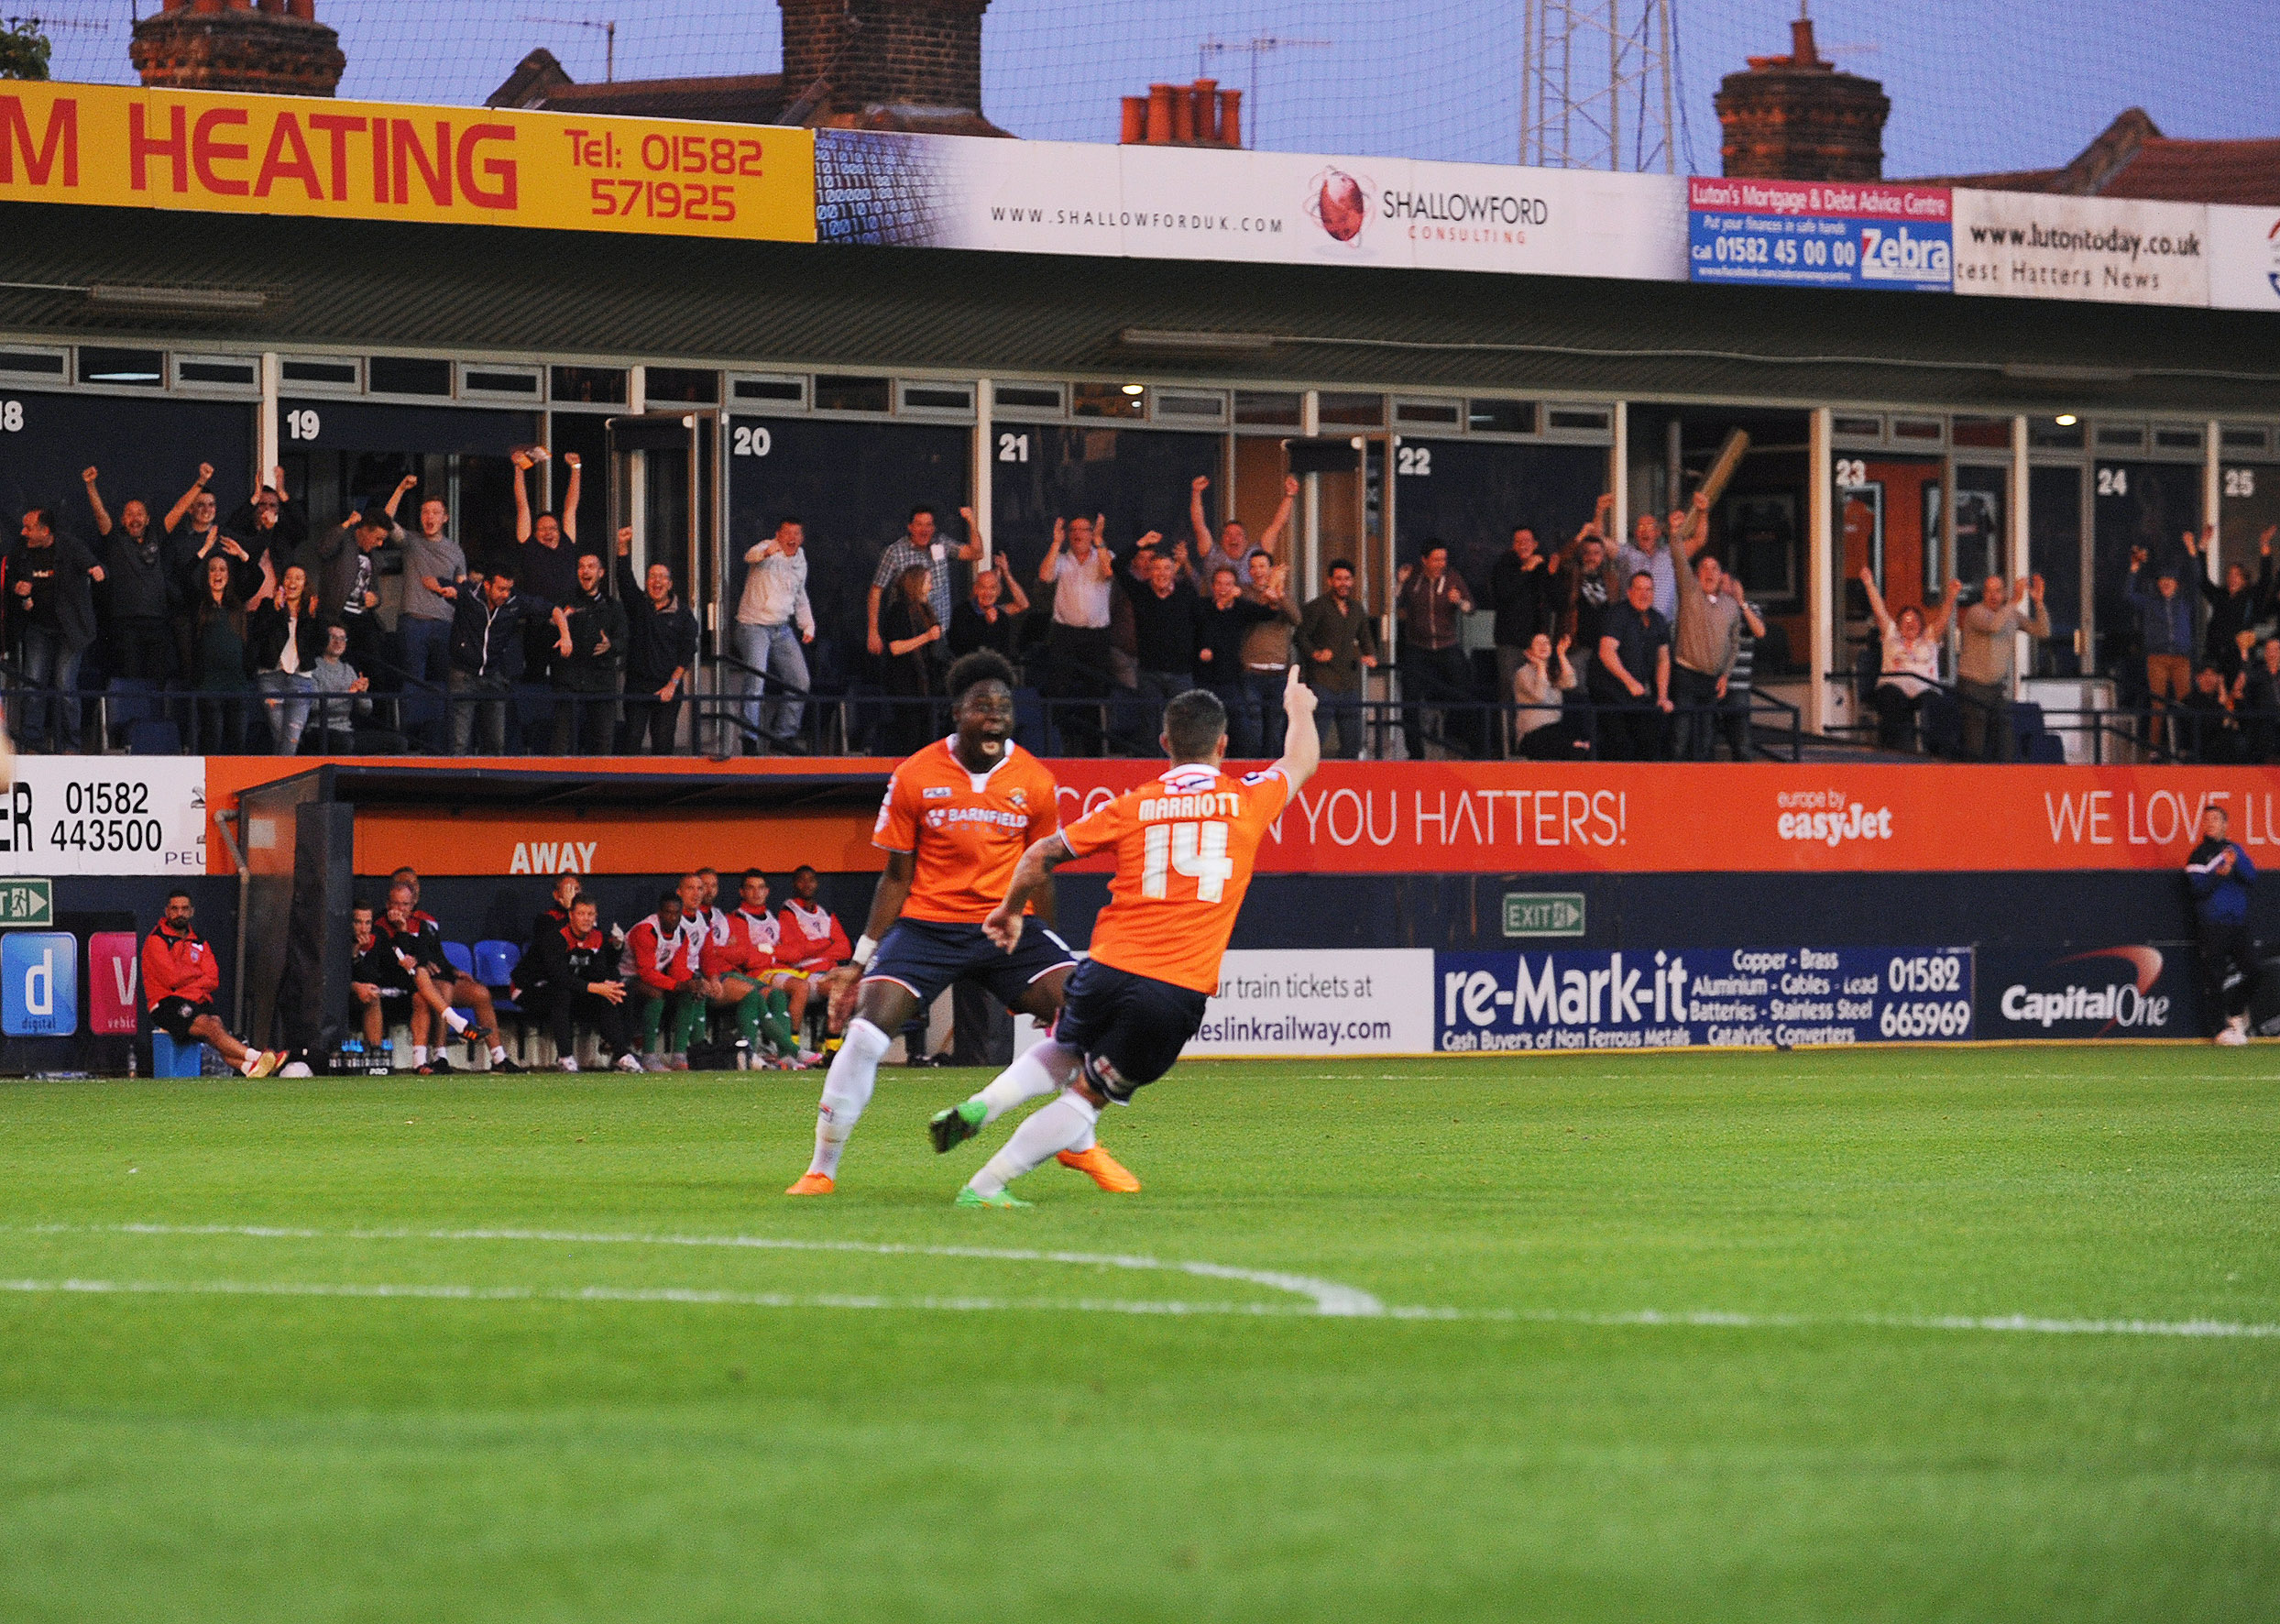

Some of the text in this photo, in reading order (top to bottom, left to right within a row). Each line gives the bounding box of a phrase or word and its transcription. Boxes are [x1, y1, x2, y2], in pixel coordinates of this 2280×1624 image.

[129, 102, 518, 210] HEATING
[564, 127, 763, 177] Tel: 01582
[591, 178, 736, 222] 571925
[1383, 190, 1548, 225] SHALLOWFORD
[1692, 183, 1947, 216] Luton's Mortgage & Debt Advice Centre
[991, 206, 1283, 233] WWW.SHALLOWFORDUK.COM
[1409, 225, 1526, 245] CONSULTING
[1692, 236, 1856, 267] Call 01582 45 00 00
[1861, 227, 1951, 269] Zebra
[1970, 223, 2201, 262] www.lutontoday.co.uk
[2011, 259, 2091, 287] Hatters
[2104, 266, 2160, 290] News
[0, 400, 24, 432] 8
[287, 410, 321, 440] 19
[734, 426, 771, 455] 20
[999, 433, 1029, 463] 21
[1398, 447, 1432, 476] 22
[1836, 458, 1866, 487] 23
[2098, 468, 2127, 498] 24
[2226, 469, 2254, 498] 25
[66, 782, 148, 814] 01582
[1138, 793, 1239, 821] MARRIOTT
[1778, 789, 1847, 811] europe by
[948, 808, 1028, 828] BARNFIELD
[1298, 788, 1398, 846] YOU
[1416, 789, 1626, 846] HATTERS!
[1778, 802, 1893, 847] easyJet
[2044, 790, 2113, 844] WE
[50, 819, 162, 851] 443500
[510, 841, 597, 874] AWAY
[1142, 820, 1233, 903] 14
[1509, 905, 1551, 927] EXIT
[1733, 948, 1839, 974] Copper Brass
[1889, 957, 1960, 993] 01582
[26, 949, 53, 1015] d
[1237, 974, 1281, 998] train
[1286, 973, 1348, 998] tickets
[1354, 975, 1373, 998] at
[1444, 949, 1688, 1026] re-Mark-it
[1692, 973, 1879, 996] Aluminium Cables Lead
[22, 1017, 56, 1030] digital
[1689, 998, 1873, 1021] Batteries Stainless Steel
[1880, 1001, 1970, 1037] 665969
[1442, 1026, 1691, 1052] Cash Buyers of Non Ferrous Metals
[1707, 1024, 1855, 1046] Catalytic Converters
